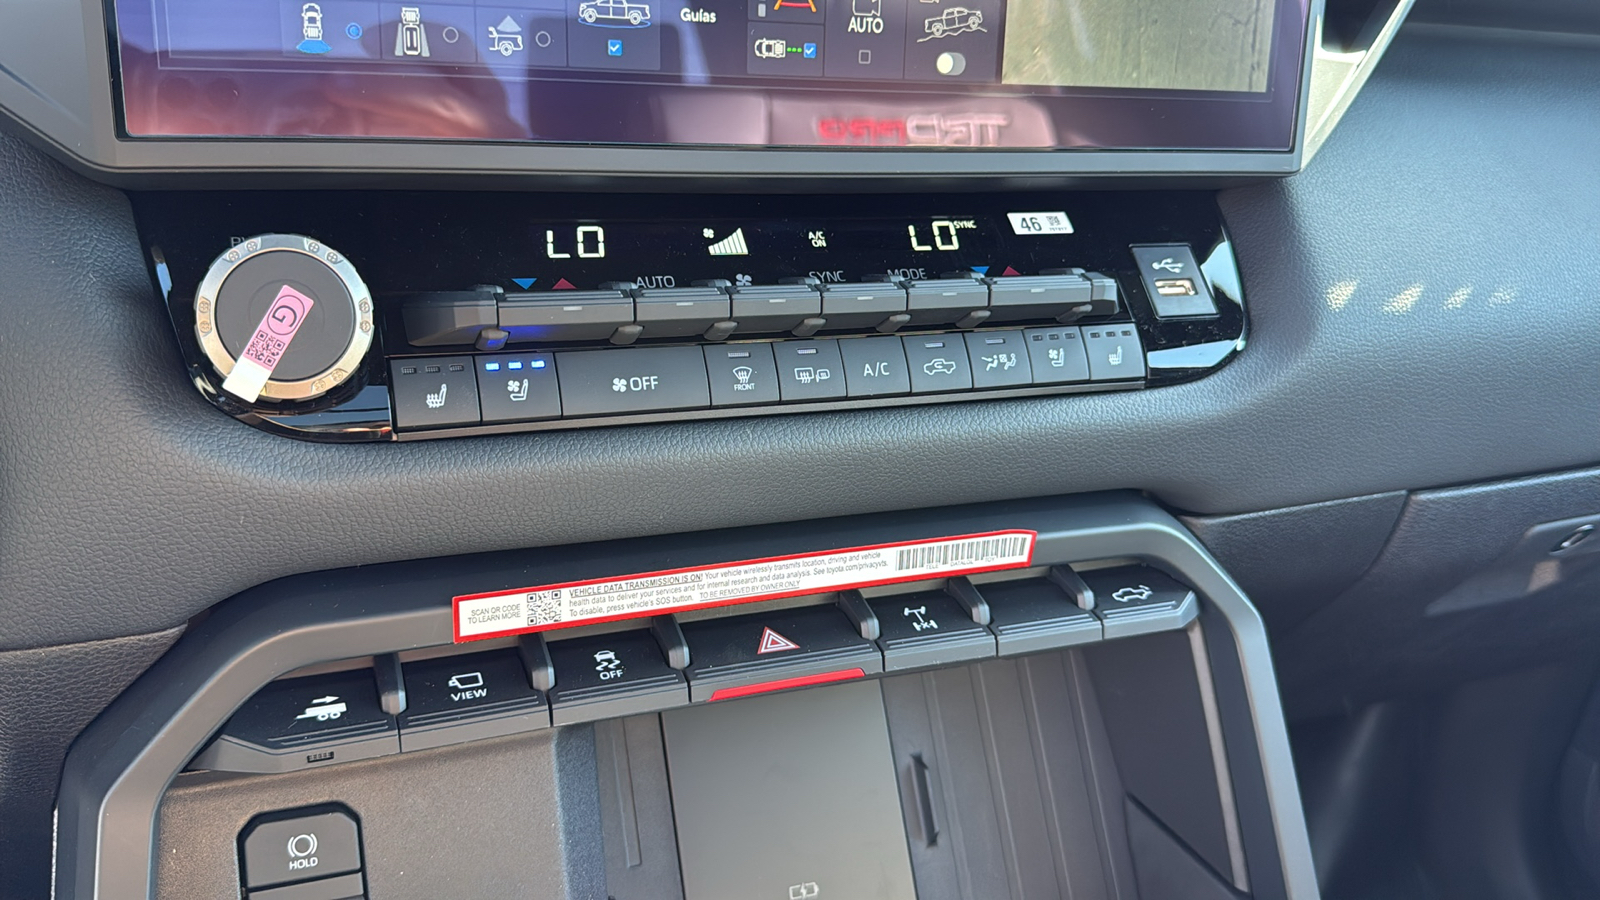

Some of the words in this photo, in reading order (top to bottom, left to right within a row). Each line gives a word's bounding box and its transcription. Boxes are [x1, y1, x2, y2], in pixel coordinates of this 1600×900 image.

[848, 16, 884, 34] AUTO
[1020, 216, 1042, 232] 46
[546, 225, 605, 258] LO
[808, 230, 825, 241] A/C
[908, 220, 960, 251] LO
[953, 219, 977, 229] SYNC
[811, 239, 827, 248] ON
[808, 270, 846, 284] SYNC
[887, 268, 927, 281] MODE
[635, 275, 675, 290] AUTO
[272, 305, 297, 327] G
[863, 362, 890, 377] A/C
[629, 376, 659, 391] OFF
[734, 382, 755, 391] FRONT
[569, 586, 602, 597] VEHICLE
[604, 584, 623, 593] DATA
[625, 577, 680, 590] TRANSMISSION
[690, 573, 703, 581] ON!
[705, 571, 719, 579] Your
[720, 568, 742, 577] vehicle
[743, 564, 773, 575] wirelessly
[774, 561, 801, 571] transmits
[802, 558, 827, 567] location,
[828, 555, 847, 565] driving
[861, 552, 881, 560] vehicle
[569, 597, 590, 607] health
[592, 595, 606, 605] data
[608, 594, 615, 602] to
[616, 591, 638, 600] deliver
[639, 589, 654, 600] your
[655, 586, 682, 596] services
[697, 582, 705, 590] for
[707, 578, 730, 589] internal
[731, 576, 757, 586] research
[759, 574, 771, 582] and
[772, 572, 785, 581] data
[813, 567, 825, 576] See
[700, 591, 708, 599] TO
[709, 590, 718, 598] BE
[719, 586, 750, 596] REMOVED
[760, 582, 784, 591] OWNER
[784, 580, 801, 589] ONLY
[471, 608, 490, 617] SCAN
[502, 603, 521, 612] CODE
[569, 609, 578, 617] To
[579, 605, 605, 616] disable,
[606, 602, 625, 613] press
[626, 596, 654, 606] vehicle's
[655, 596, 671, 605] SOS
[478, 614, 501, 623] LEARN
[501, 611, 521, 620] MORE
[600, 669, 623, 680] OFF
[451, 687, 487, 701] VIEW
[289, 857, 318, 870] HOLD
